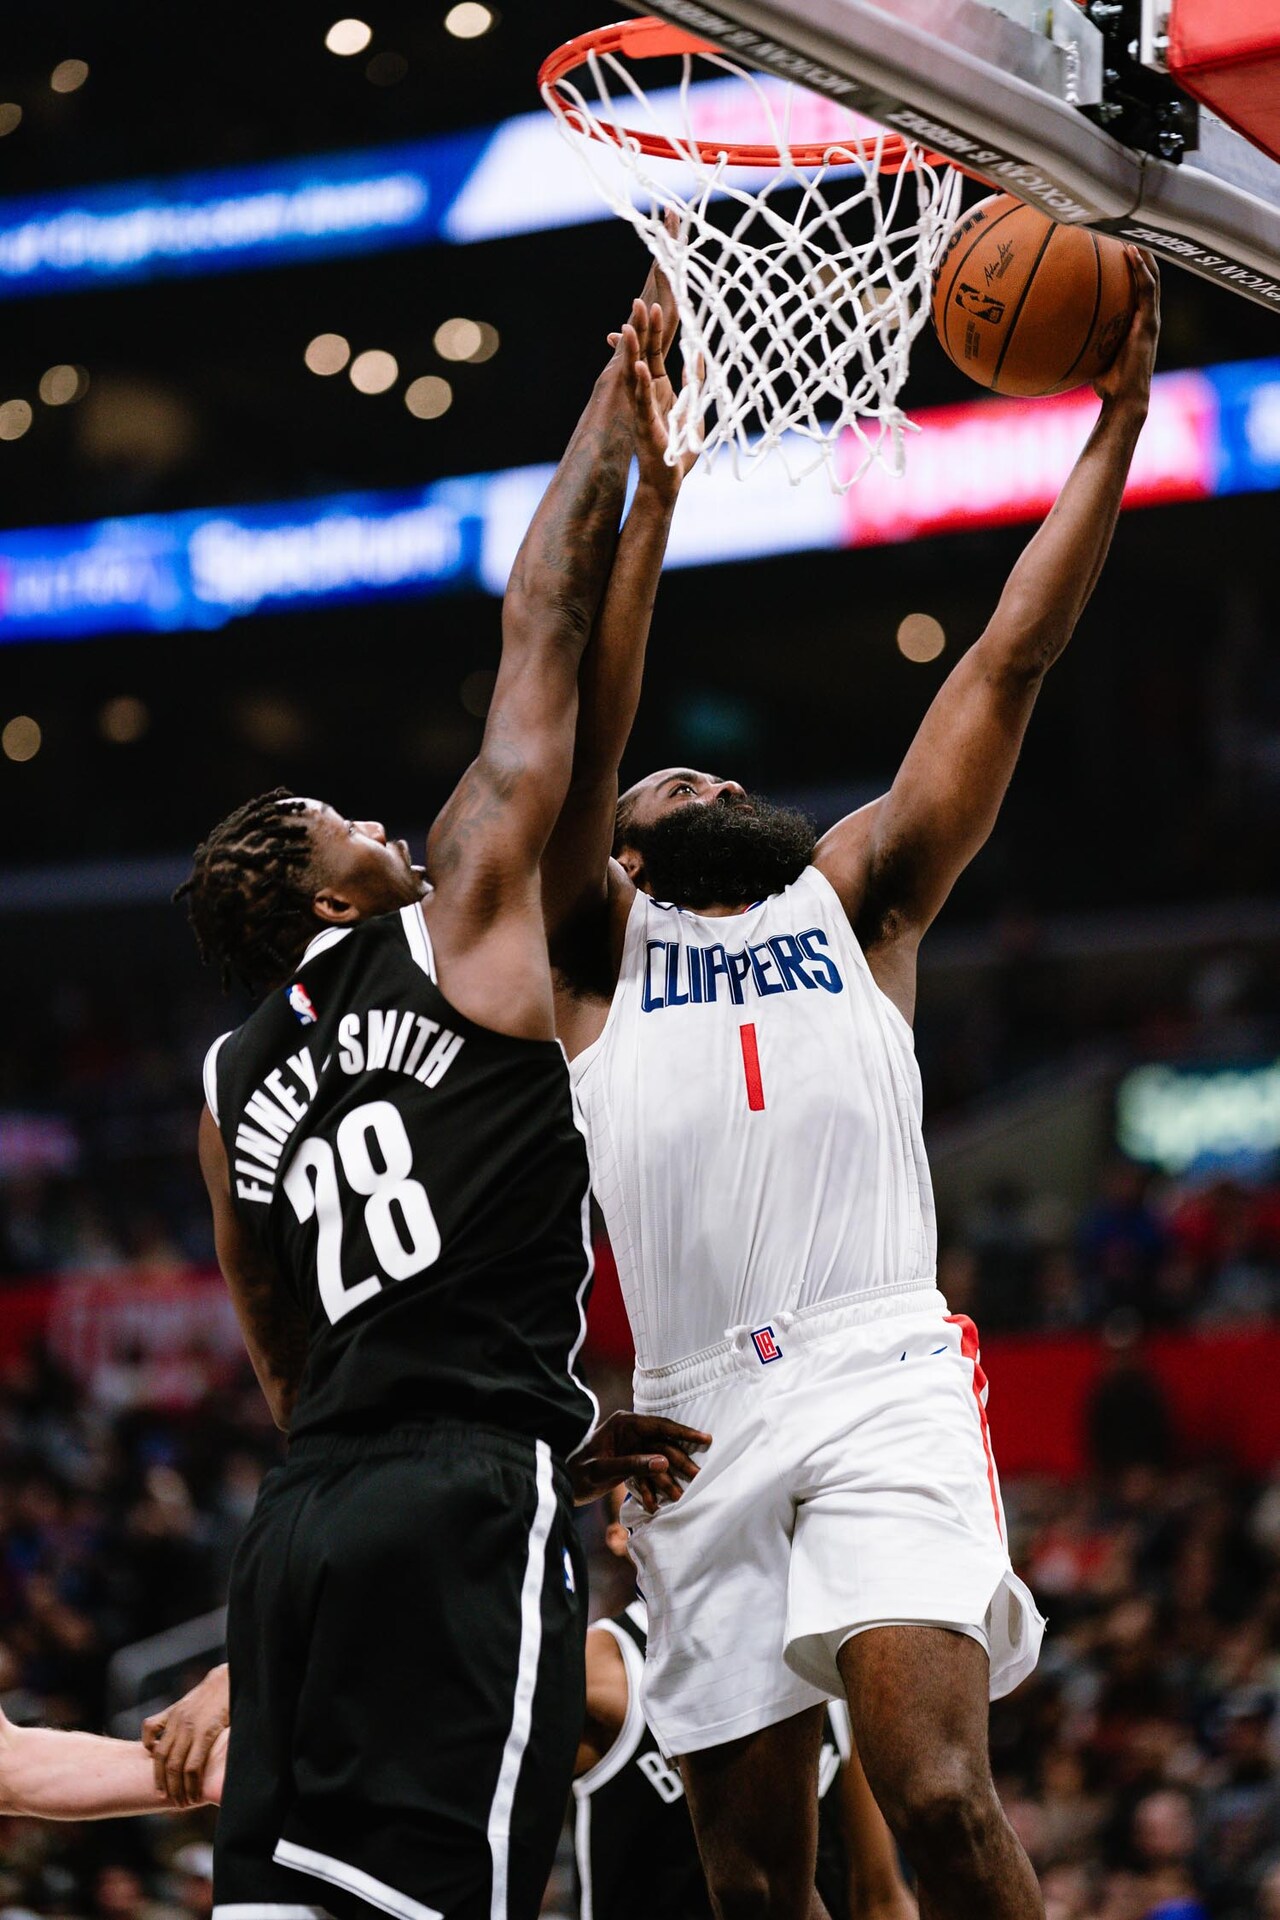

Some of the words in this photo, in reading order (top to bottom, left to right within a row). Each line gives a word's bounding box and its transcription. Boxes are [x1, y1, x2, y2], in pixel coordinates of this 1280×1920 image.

[967, 150, 1004, 164] IS
[1120, 227, 1206, 257] HERDEZ
[1194, 255, 1226, 267] IS
[641, 927, 843, 1013] CLIPPERS
[739, 1022, 766, 1112] 1
[282, 1100, 442, 1327] 28
